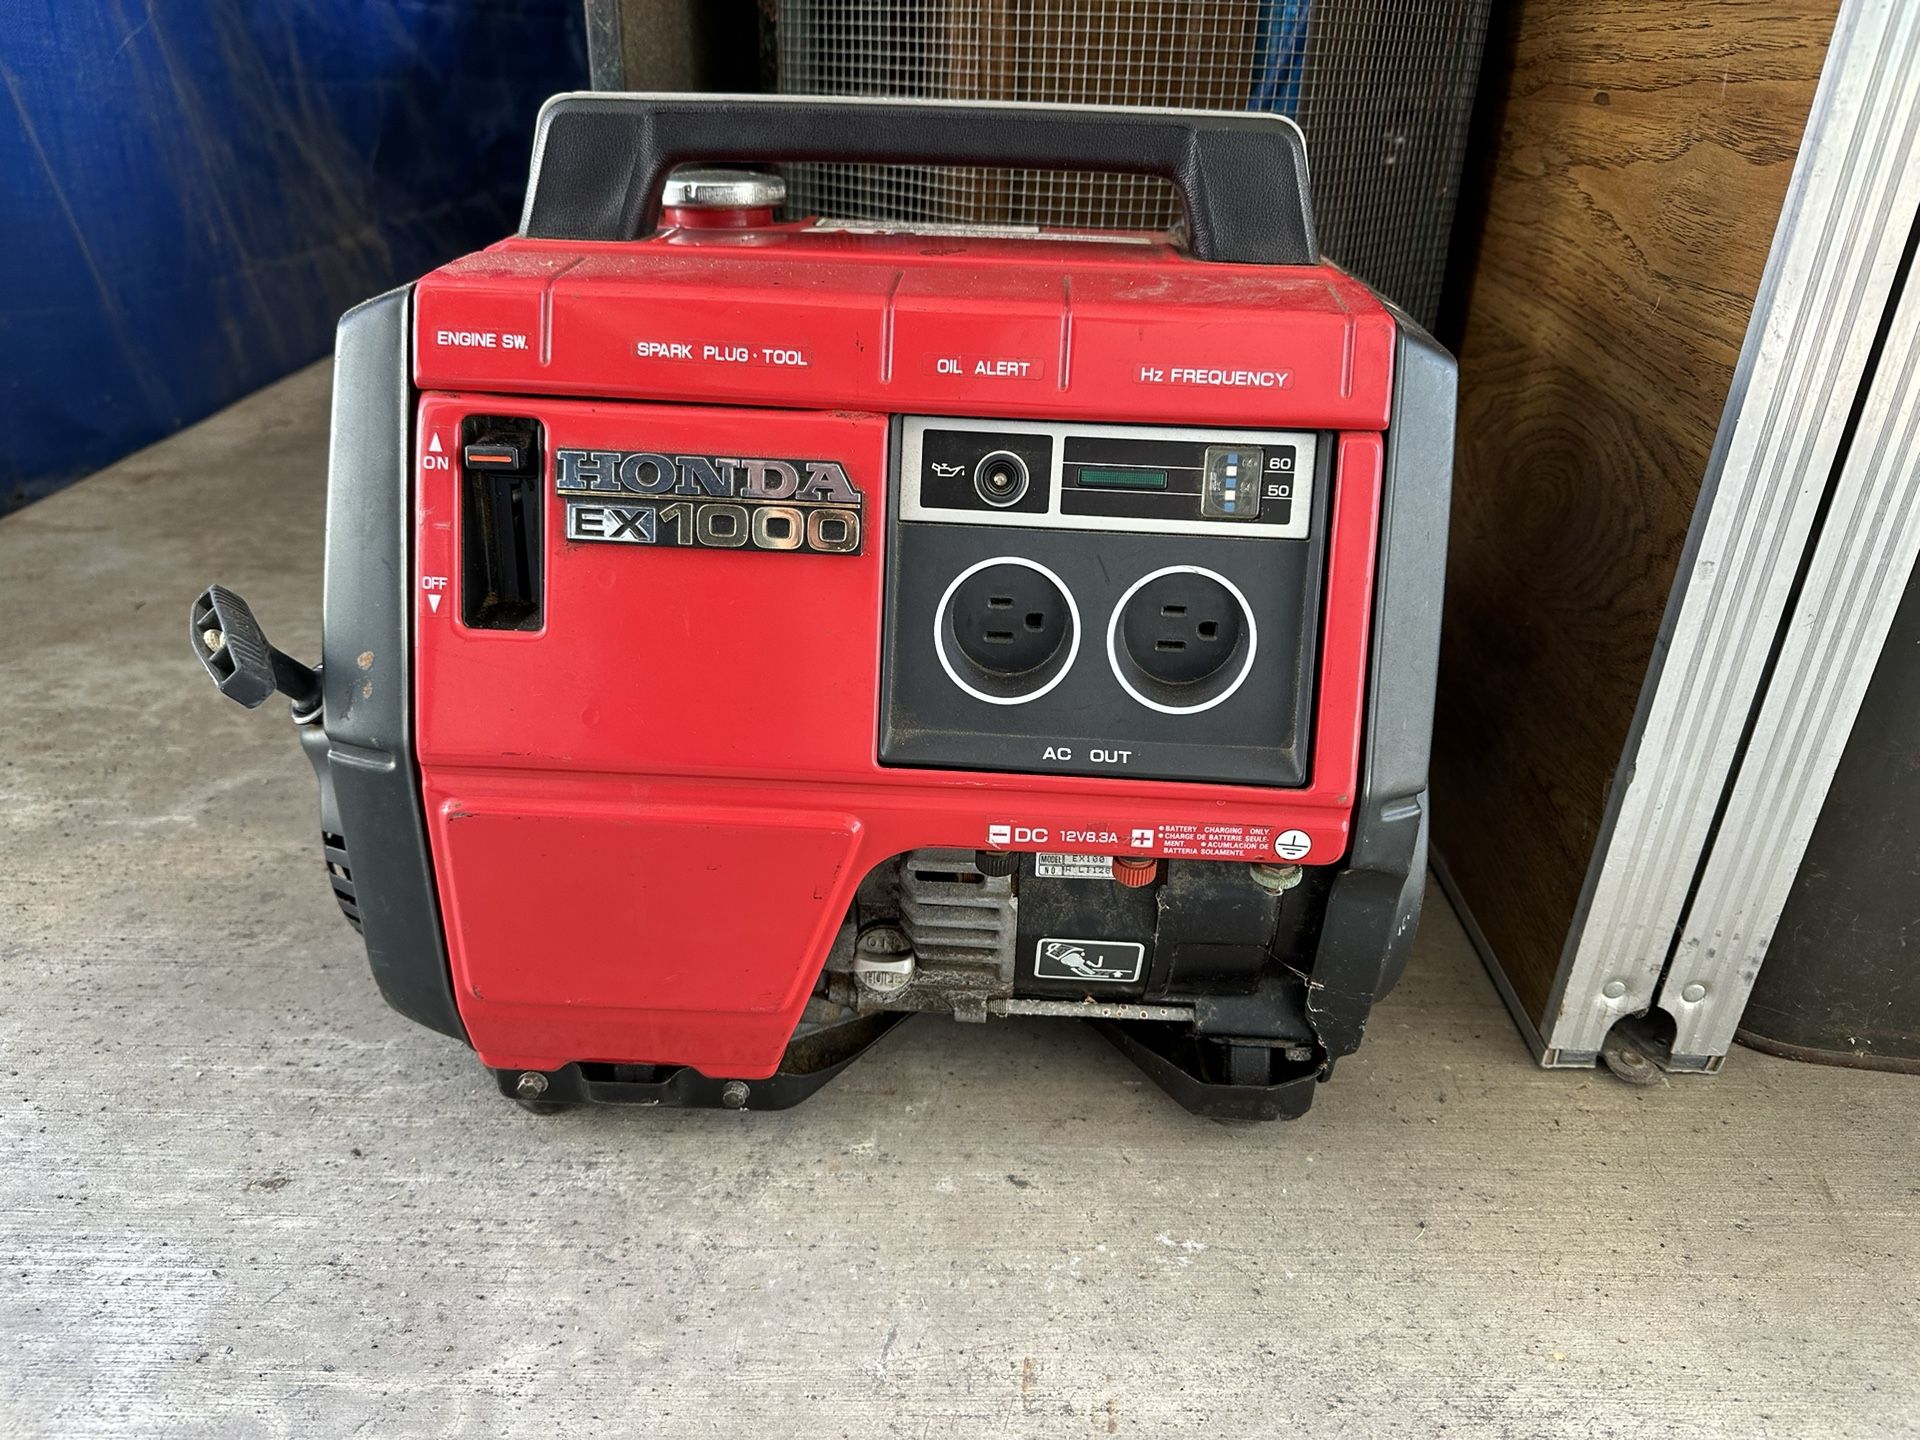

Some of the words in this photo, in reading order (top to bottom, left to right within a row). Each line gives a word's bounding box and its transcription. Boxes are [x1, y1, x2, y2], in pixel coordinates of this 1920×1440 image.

[437, 330, 497, 348] ENGINE
[501, 334, 529, 350] SW.
[637, 341, 693, 360] SPARK
[703, 345, 749, 362] PLUG
[762, 349, 808, 366] TOOL
[936, 358, 963, 375] OIL
[974, 360, 1031, 377] ALERT
[1140, 367, 1164, 383] Hz
[1170, 367, 1289, 387] FREQUENCY
[422, 455, 449, 470] ON
[1269, 457, 1292, 470] 60
[556, 450, 861, 503] HONDA
[1267, 484, 1290, 497] 50
[566, 502, 860, 553] EX1000
[422, 575, 449, 590] OFF
[1042, 746, 1072, 761] AC
[1089, 748, 1132, 764] OUT
[1014, 827, 1049, 843] DC
[1059, 830, 1118, 844] 12V8.3A
[1165, 825, 1198, 833] BATTERY
[1204, 826, 1243, 834] CHARGING
[1208, 834, 1242, 842] BATTERIE
[1040, 855, 1062, 864] MODEL
